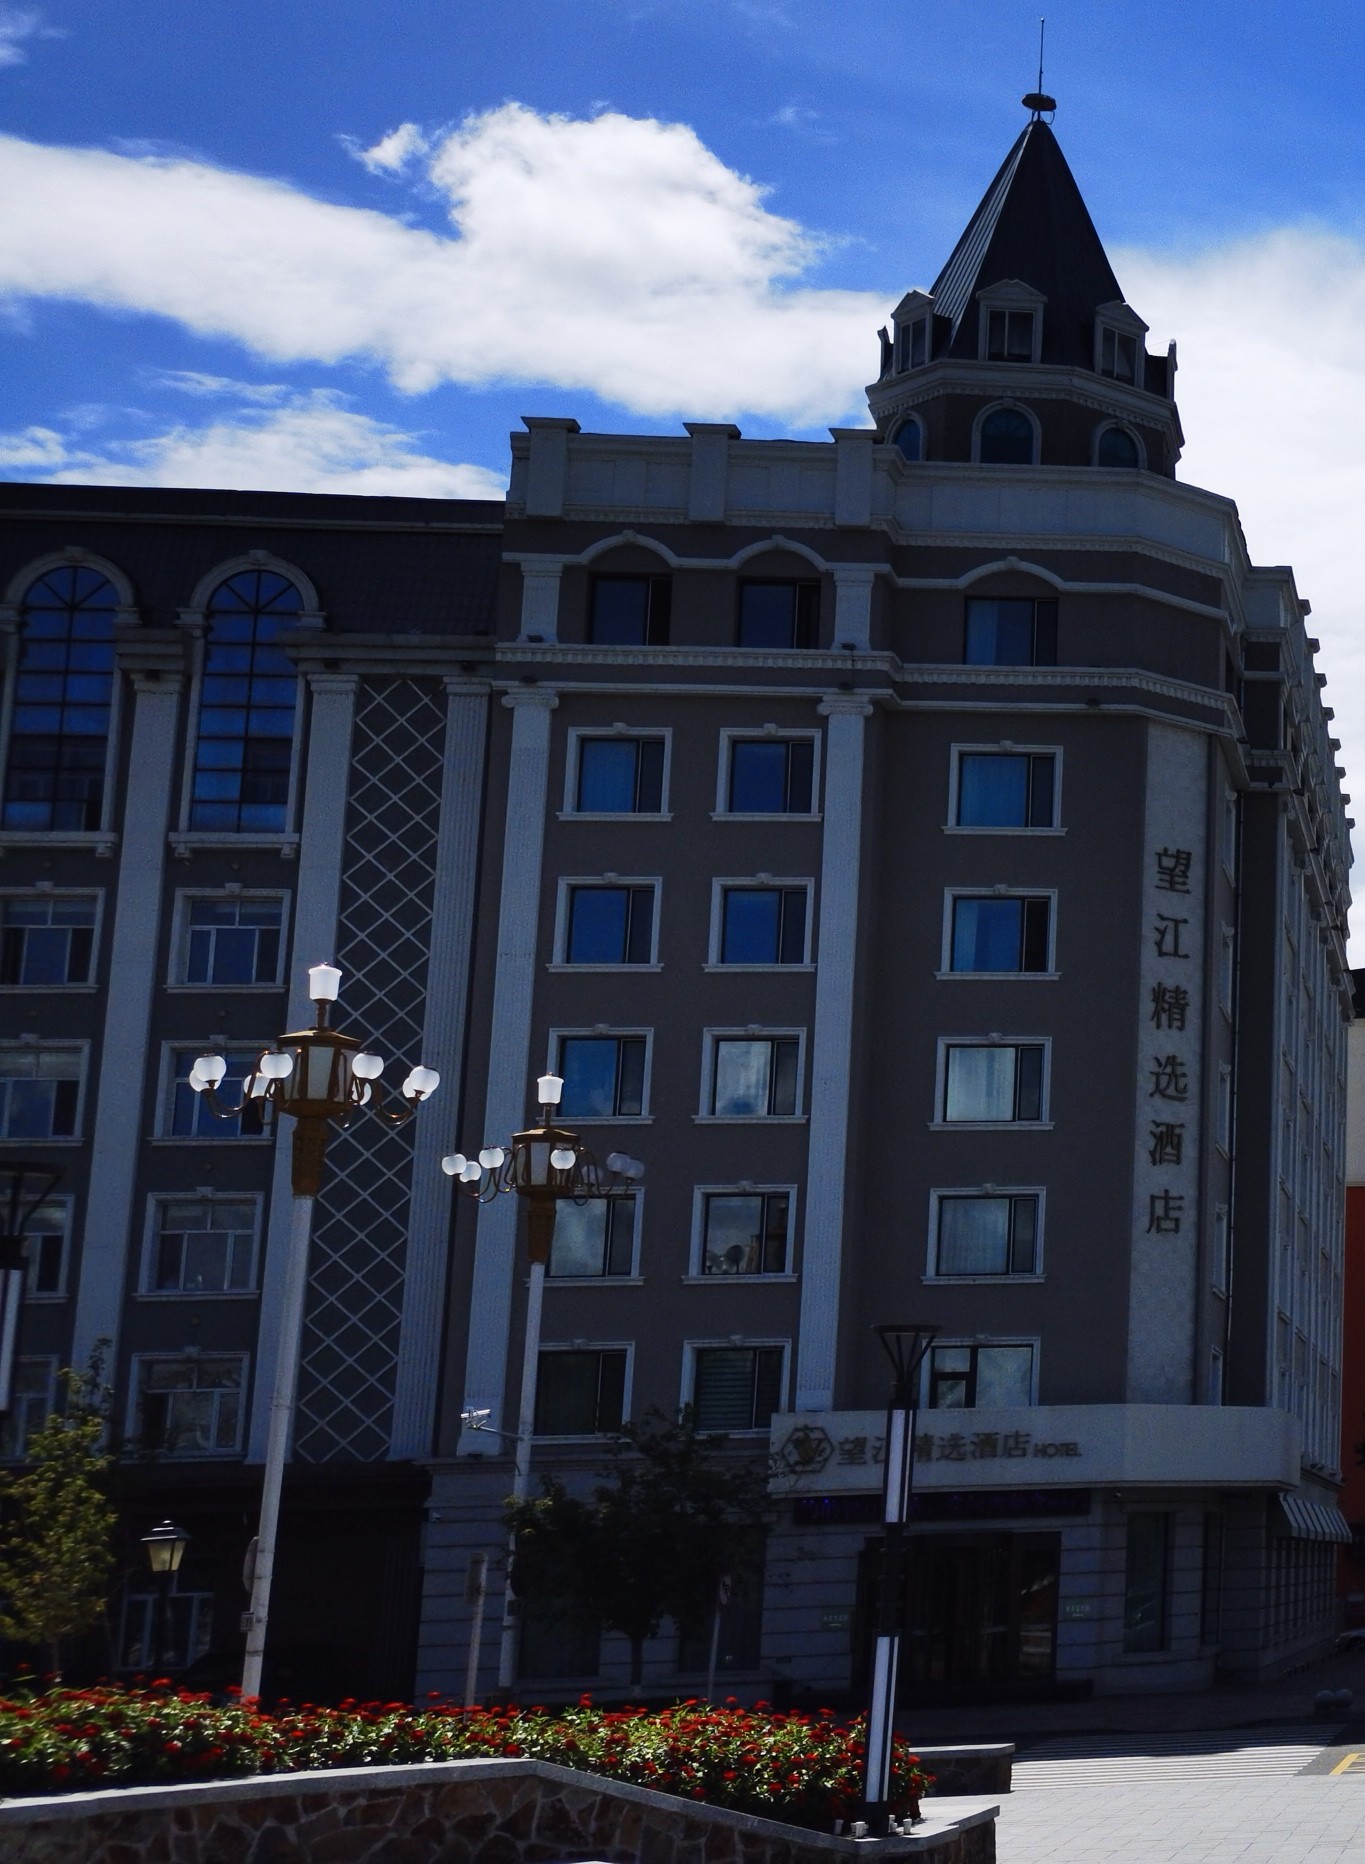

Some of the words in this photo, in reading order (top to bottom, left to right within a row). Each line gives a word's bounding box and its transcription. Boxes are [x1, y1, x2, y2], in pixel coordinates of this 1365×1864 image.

[1144, 846, 1192, 1235] 望江精选酒店
[1033, 1442, 1083, 1458] HOTEL
